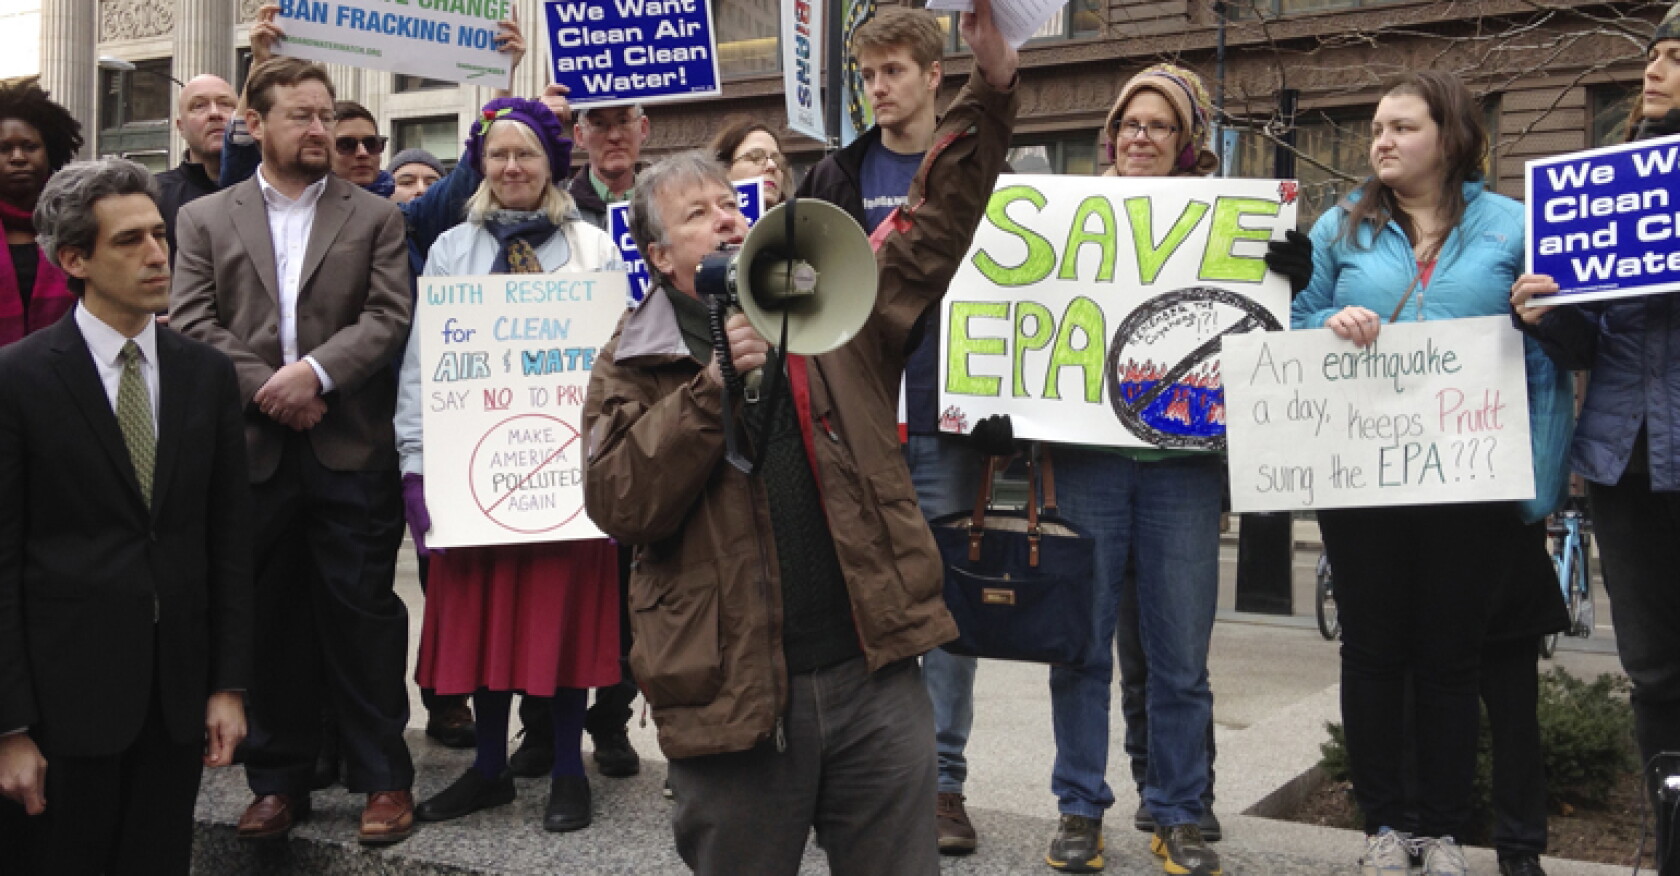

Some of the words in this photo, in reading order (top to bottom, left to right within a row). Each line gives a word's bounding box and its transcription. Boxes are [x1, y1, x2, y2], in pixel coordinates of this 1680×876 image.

[278, 0, 328, 24] BAN
[336, 5, 450, 44] FRACKING
[555, 2, 605, 23] We
[613, 0, 697, 18] Want
[558, 26, 643, 47] Clean
[654, 19, 701, 40] Air
[558, 50, 613, 72] and
[623, 45, 707, 66] Clean
[794, 0, 812, 109] BIANS
[582, 66, 687, 94] Water!
[1547, 161, 1615, 191] We
[1545, 188, 1669, 223] Clean
[971, 185, 1281, 287] SAVE
[1539, 221, 1617, 256] and
[427, 283, 483, 305] WITH
[505, 280, 597, 303] RESPECT
[441, 318, 476, 344] for
[493, 316, 571, 342] CLEAN
[432, 350, 491, 382] AIR
[521, 347, 597, 376] WATE
[945, 296, 1106, 404] EPA
[1250, 341, 1303, 386] An
[1322, 337, 1462, 393] earthquake
[430, 389, 470, 412] SAY
[484, 387, 513, 412] NO
[528, 386, 549, 408] TO
[556, 385, 589, 406] PRU
[1253, 400, 1270, 424] a
[1287, 389, 1331, 437] day,
[1348, 402, 1424, 447] keeps
[508, 428, 555, 445] MAKE
[490, 449, 567, 469] AMERICA
[492, 468, 583, 493] POLLUTED
[1256, 463, 1314, 505] suing
[1328, 454, 1366, 489] the
[508, 492, 556, 512] AGAIN
